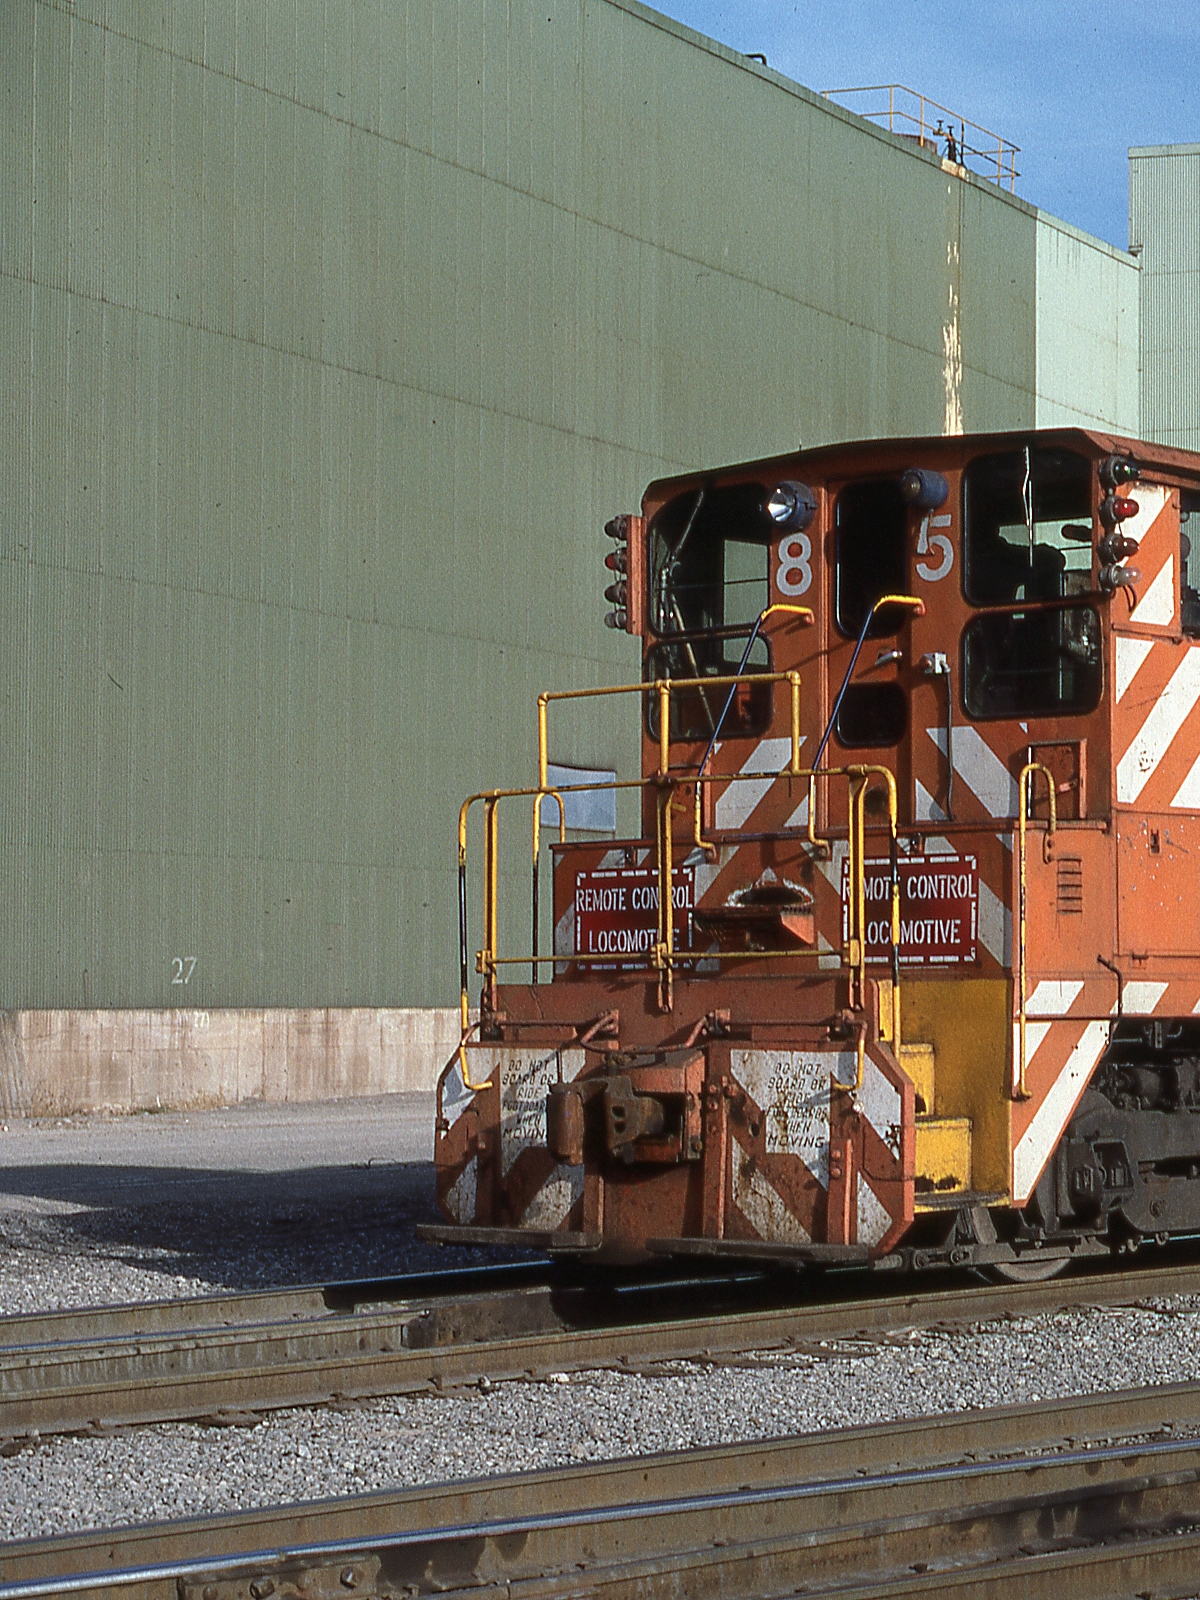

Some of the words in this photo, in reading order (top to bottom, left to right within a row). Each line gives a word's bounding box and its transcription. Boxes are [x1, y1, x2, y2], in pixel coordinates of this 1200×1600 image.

[776, 532, 812, 596] 8
[916, 514, 954, 582] 5
[842, 875, 900, 901] RMOT
[907, 873, 977, 899] CONTROL
[576, 888, 627, 912] REMOTE
[632, 885, 693, 910] CONROL
[863, 919, 961, 945] OCMOTIVE
[171, 956, 197, 985] 27
[508, 1060, 522, 1071] DO
[529, 1060, 550, 1072] NOT
[775, 1063, 790, 1075] DO
[797, 1063, 821, 1075] NOT
[502, 1073, 536, 1085] BOARD
[767, 1077, 805, 1090] BOARD
[810, 1078, 826, 1091] OR
[516, 1087, 542, 1099] RIDE
[516, 1113, 543, 1126] WHEN
[502, 1127, 546, 1140] MOVIN
[767, 1134, 825, 1149] MOVING
